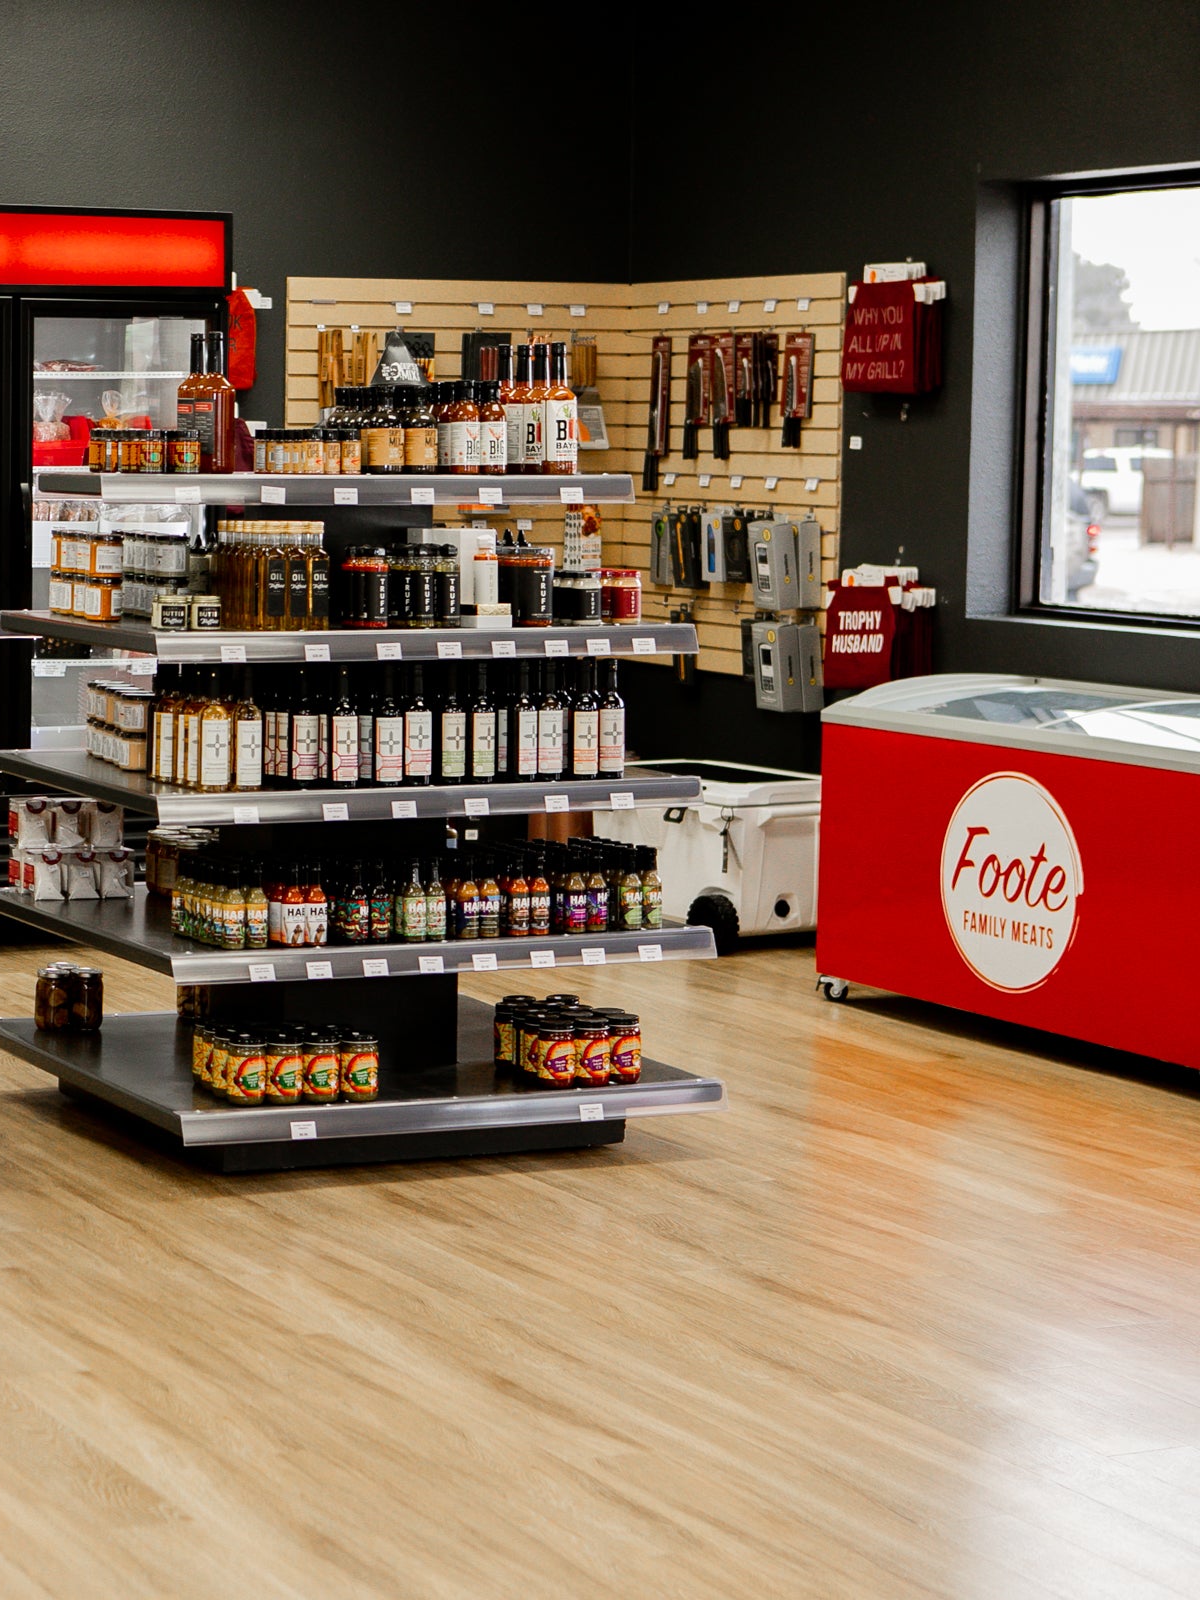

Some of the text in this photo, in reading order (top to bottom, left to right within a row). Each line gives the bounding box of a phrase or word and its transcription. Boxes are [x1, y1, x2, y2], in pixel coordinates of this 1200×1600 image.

[853, 306, 904, 326] WHY YOU
[848, 333, 902, 353] ALL UP IN
[845, 360, 905, 380] MY GRILL?
[526, 445, 542, 454] BAY
[270, 572, 284, 582] OIL
[292, 573, 306, 582] OIL
[313, 572, 328, 582] OIL
[838, 610, 882, 631] TROPHY
[831, 633, 884, 654] HUSBAND
[950, 826, 1068, 912] Foote
[223, 910, 244, 920] HAB
[480, 900, 500, 913] HAB
[963, 910, 1054, 950] FAMILY MEATS
